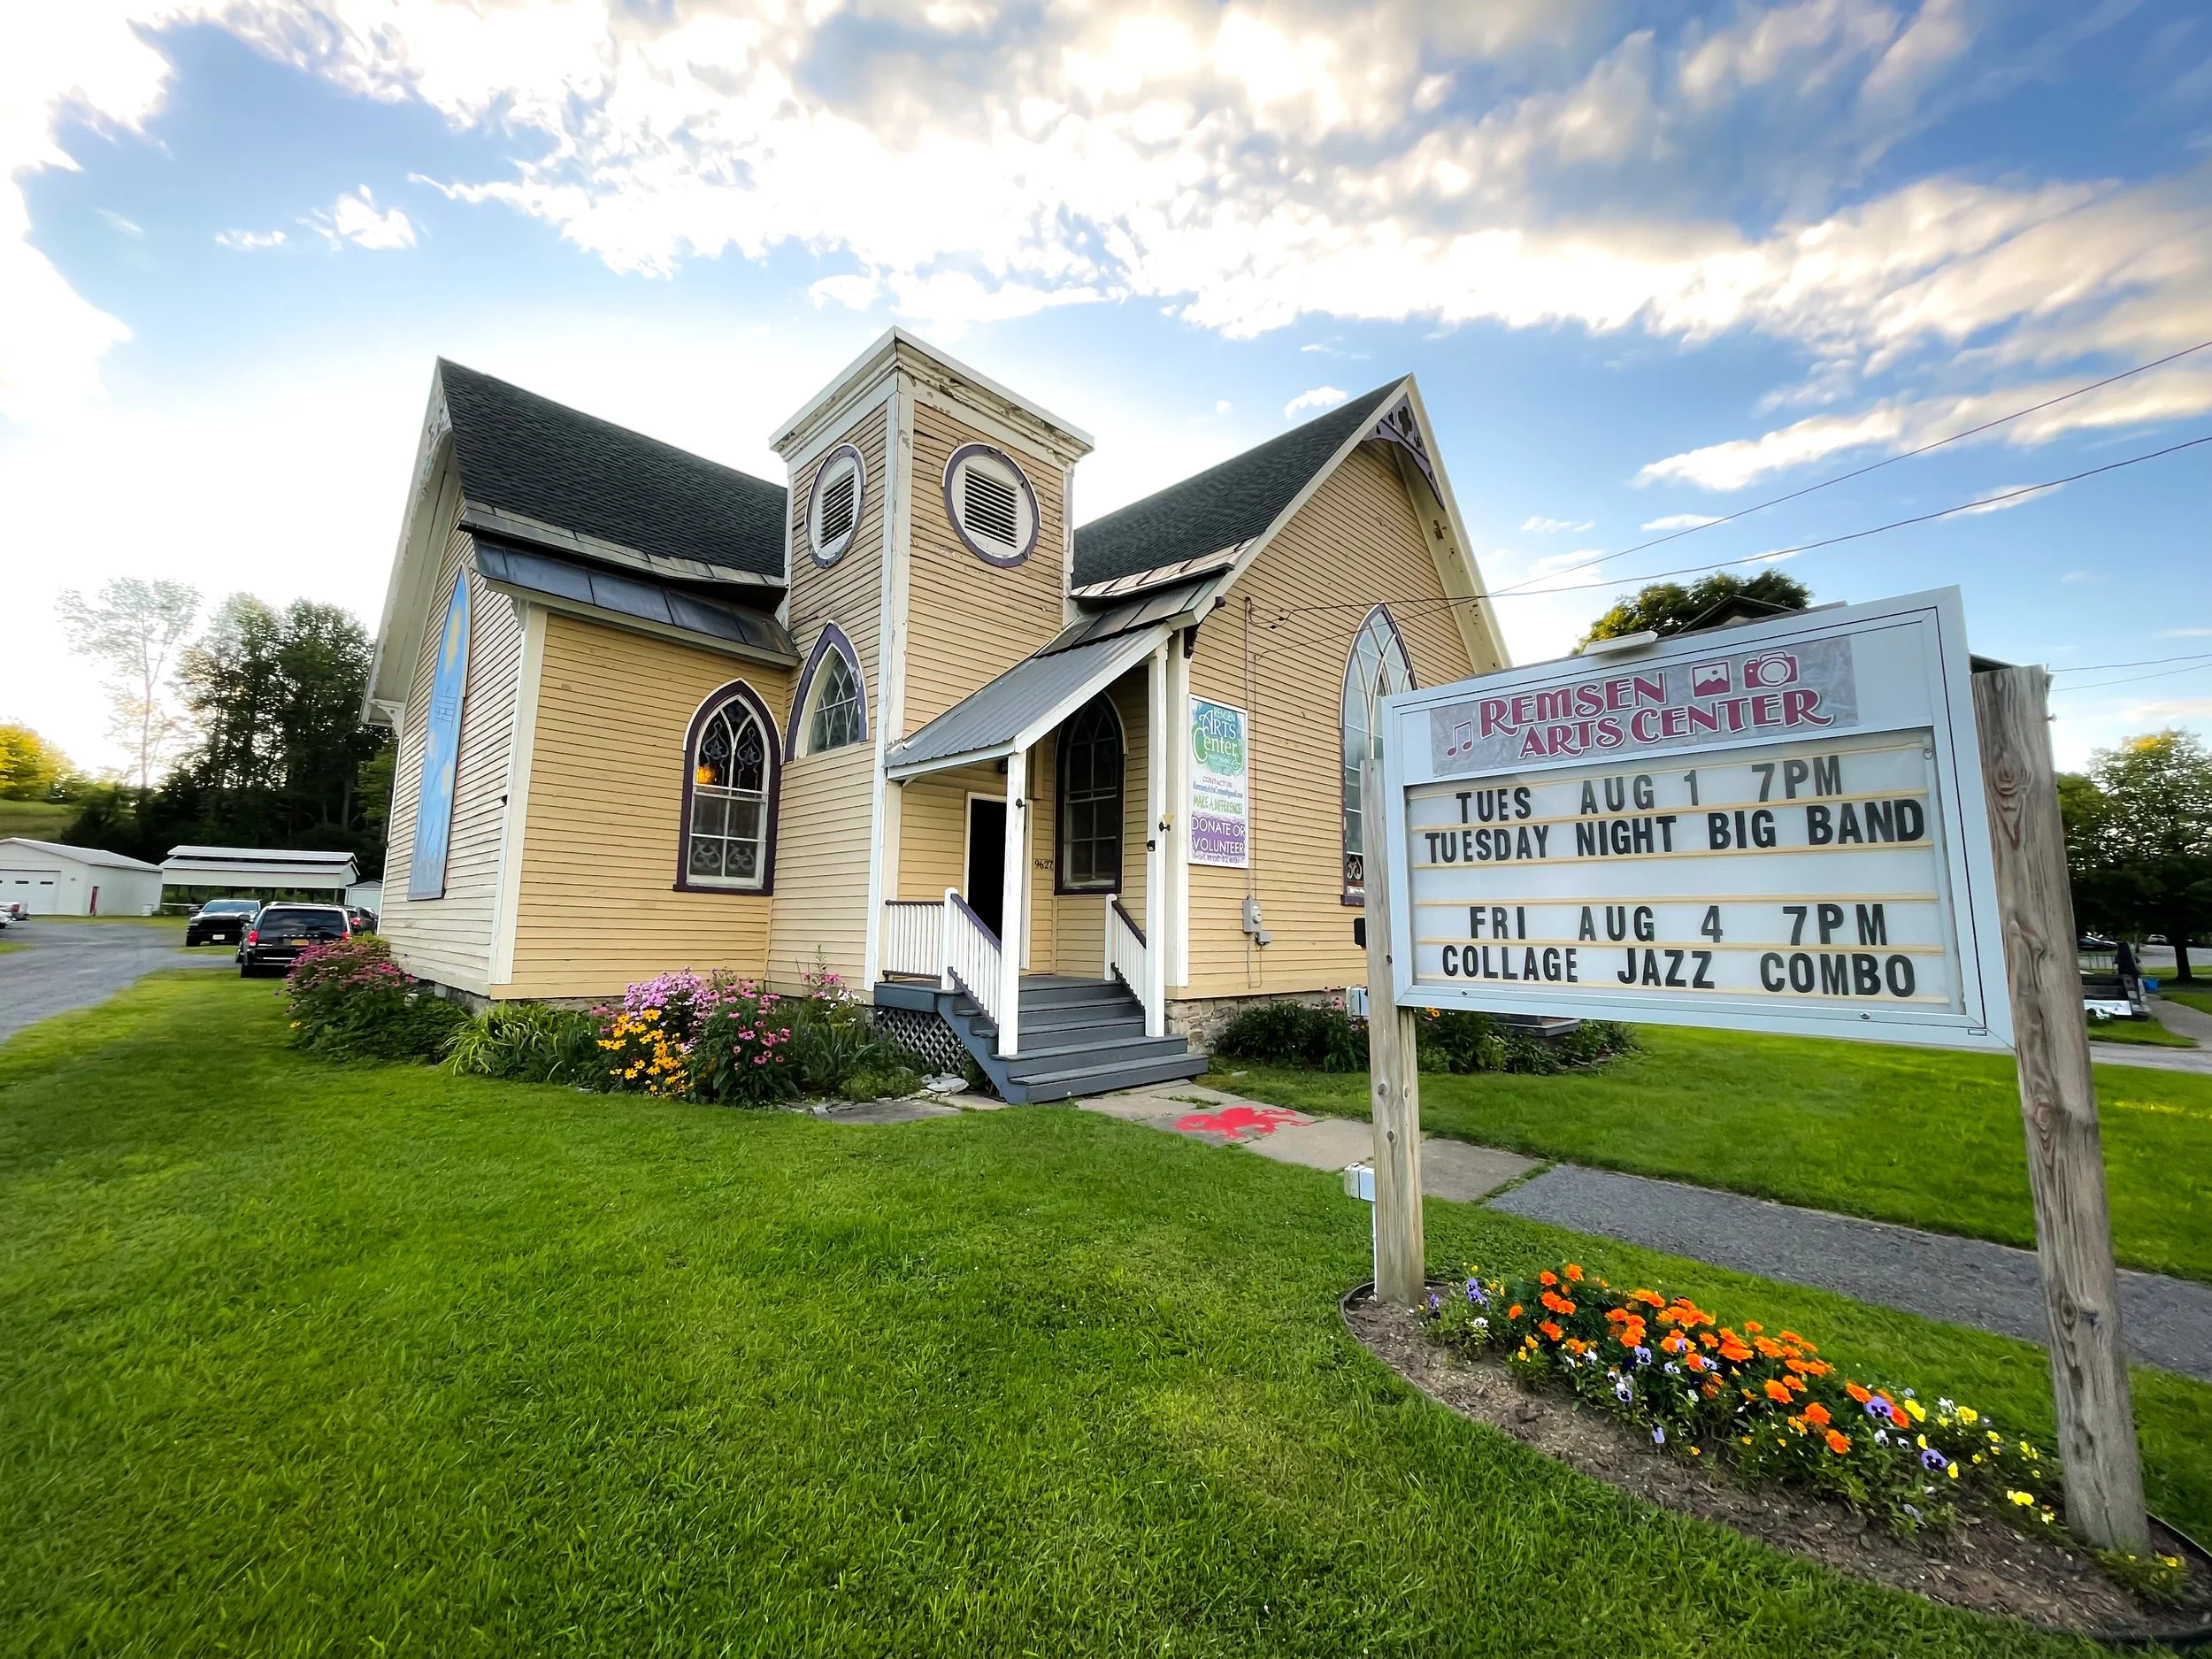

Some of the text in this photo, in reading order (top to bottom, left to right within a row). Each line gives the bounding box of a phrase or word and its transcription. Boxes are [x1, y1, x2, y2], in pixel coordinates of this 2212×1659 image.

[1199, 710, 1236, 740] ARTS
[1479, 671, 1668, 740] REMSEN
[1517, 689, 1834, 760] ARTS CENTER
[1194, 727, 1237, 762] Center
[1456, 755, 1843, 826] TUES AUG 1 7PM
[1192, 817, 1245, 837] DONATE OR
[1192, 836, 1244, 855] VOLUNTEER
[1425, 799, 1924, 864] TUESDAY NIGHT BIG BAND
[1034, 859, 1053, 869] 9627
[1469, 903, 1888, 947] FRI AUG 4 7PM
[1442, 945, 1916, 998] COLLAGE JAZZ COMBO
